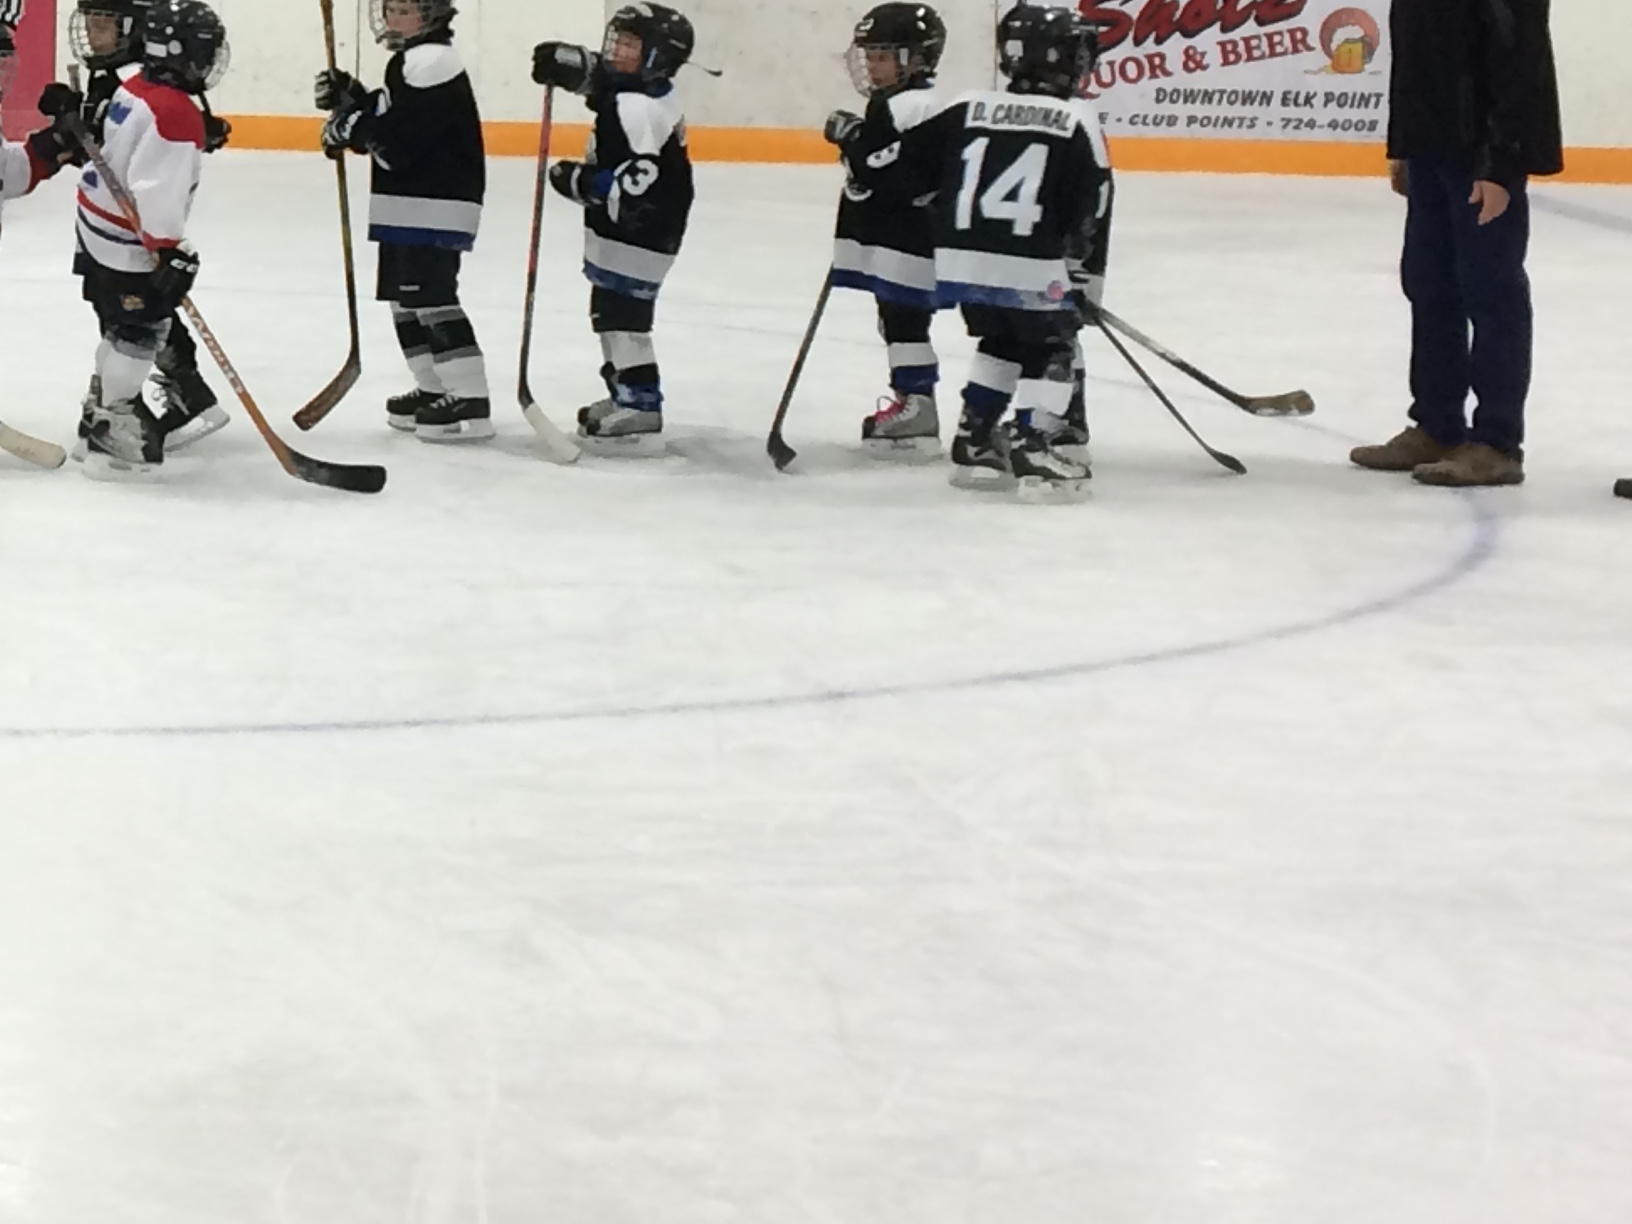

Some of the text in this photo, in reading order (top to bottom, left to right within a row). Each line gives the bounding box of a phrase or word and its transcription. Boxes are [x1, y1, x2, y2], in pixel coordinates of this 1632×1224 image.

[1181, 45, 1210, 72] &
[1217, 26, 1316, 68] BEER
[1155, 86, 1385, 112] DOWNTOWN ELK POINT
[971, 101, 1072, 132] D. CARDINAL
[1128, 113, 1178, 128] CLUB
[1186, 114, 1257, 131] POINTS
[1280, 116, 1380, 133] 724-4008
[955, 136, 1050, 237] 14
